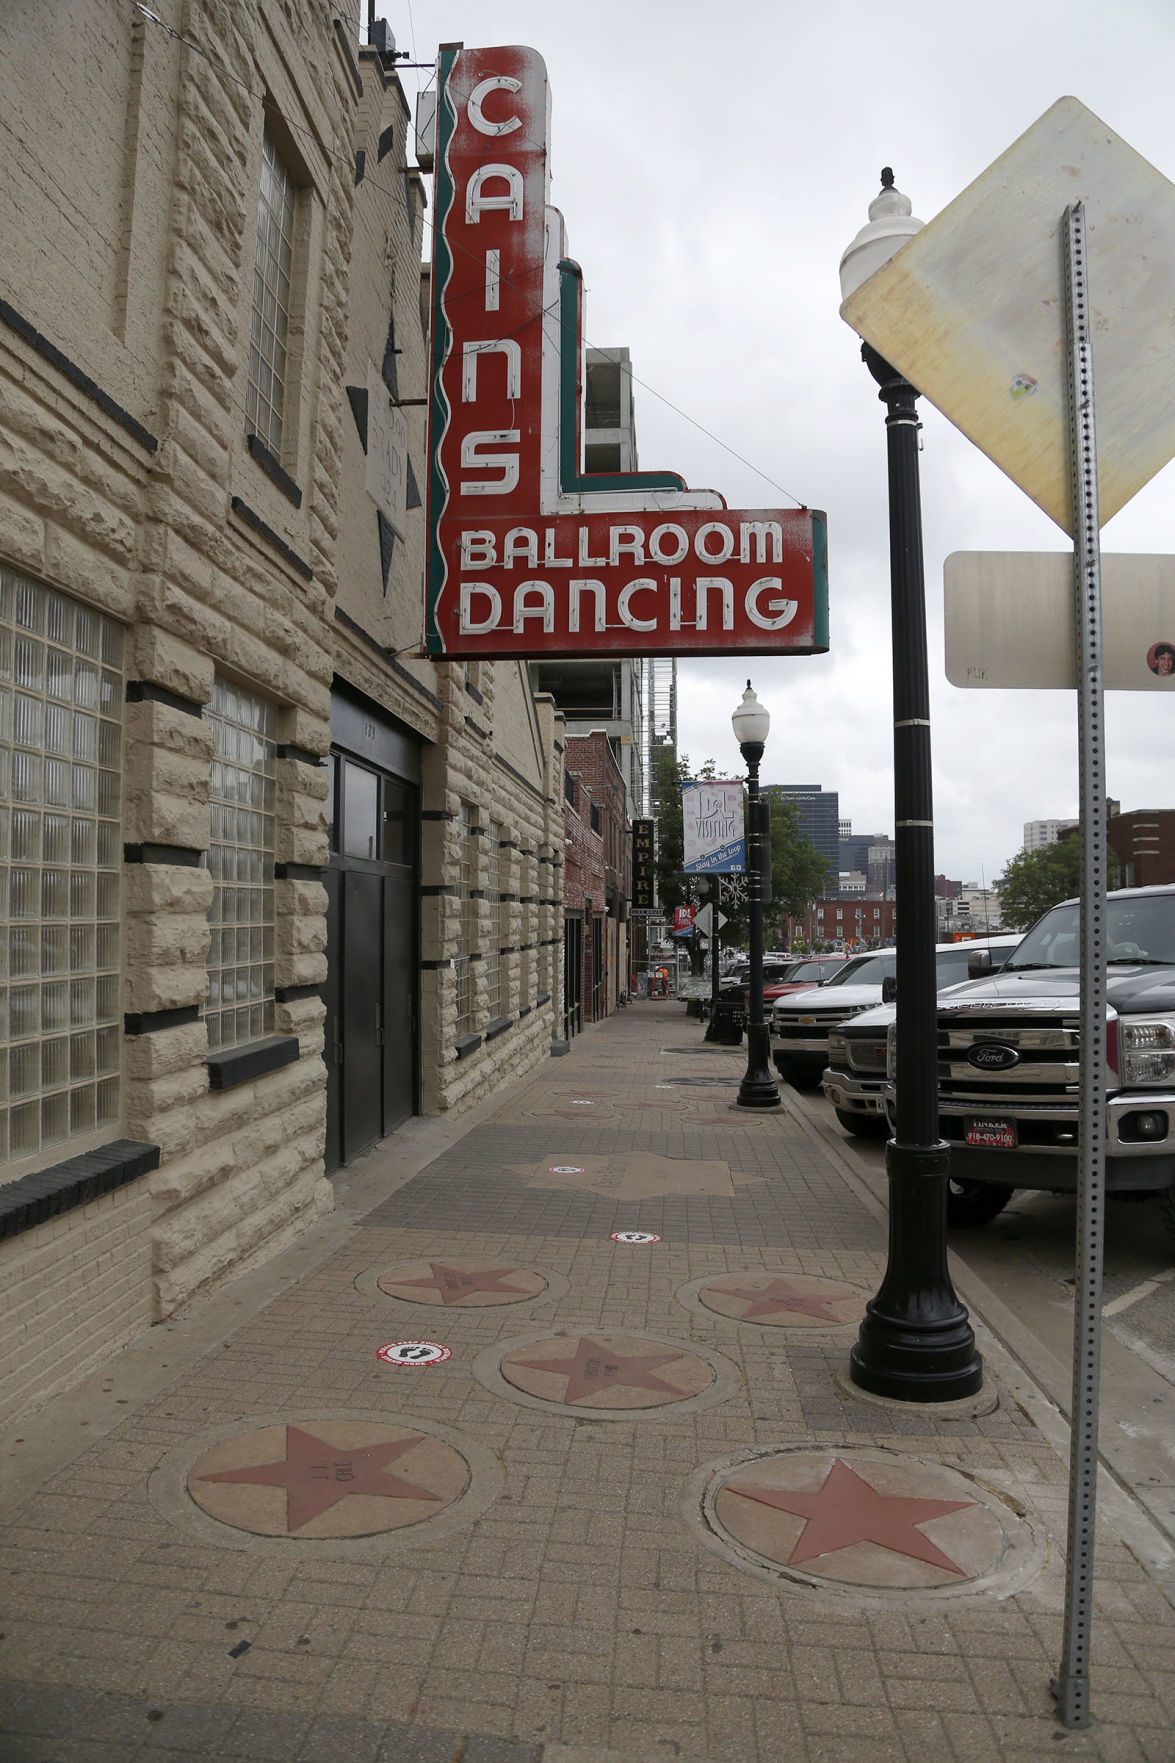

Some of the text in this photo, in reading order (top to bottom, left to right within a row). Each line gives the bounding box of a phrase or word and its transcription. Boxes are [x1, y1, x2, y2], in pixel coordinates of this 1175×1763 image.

[461, 76, 524, 496] CAINS
[460, 522, 783, 569] BALLROOM
[459, 577, 798, 635] DANCING
[636, 824, 650, 905] EMPIRE
[977, 1048, 1005, 1063] Ford
[967, 1132, 1013, 1142] 918-470-9100
